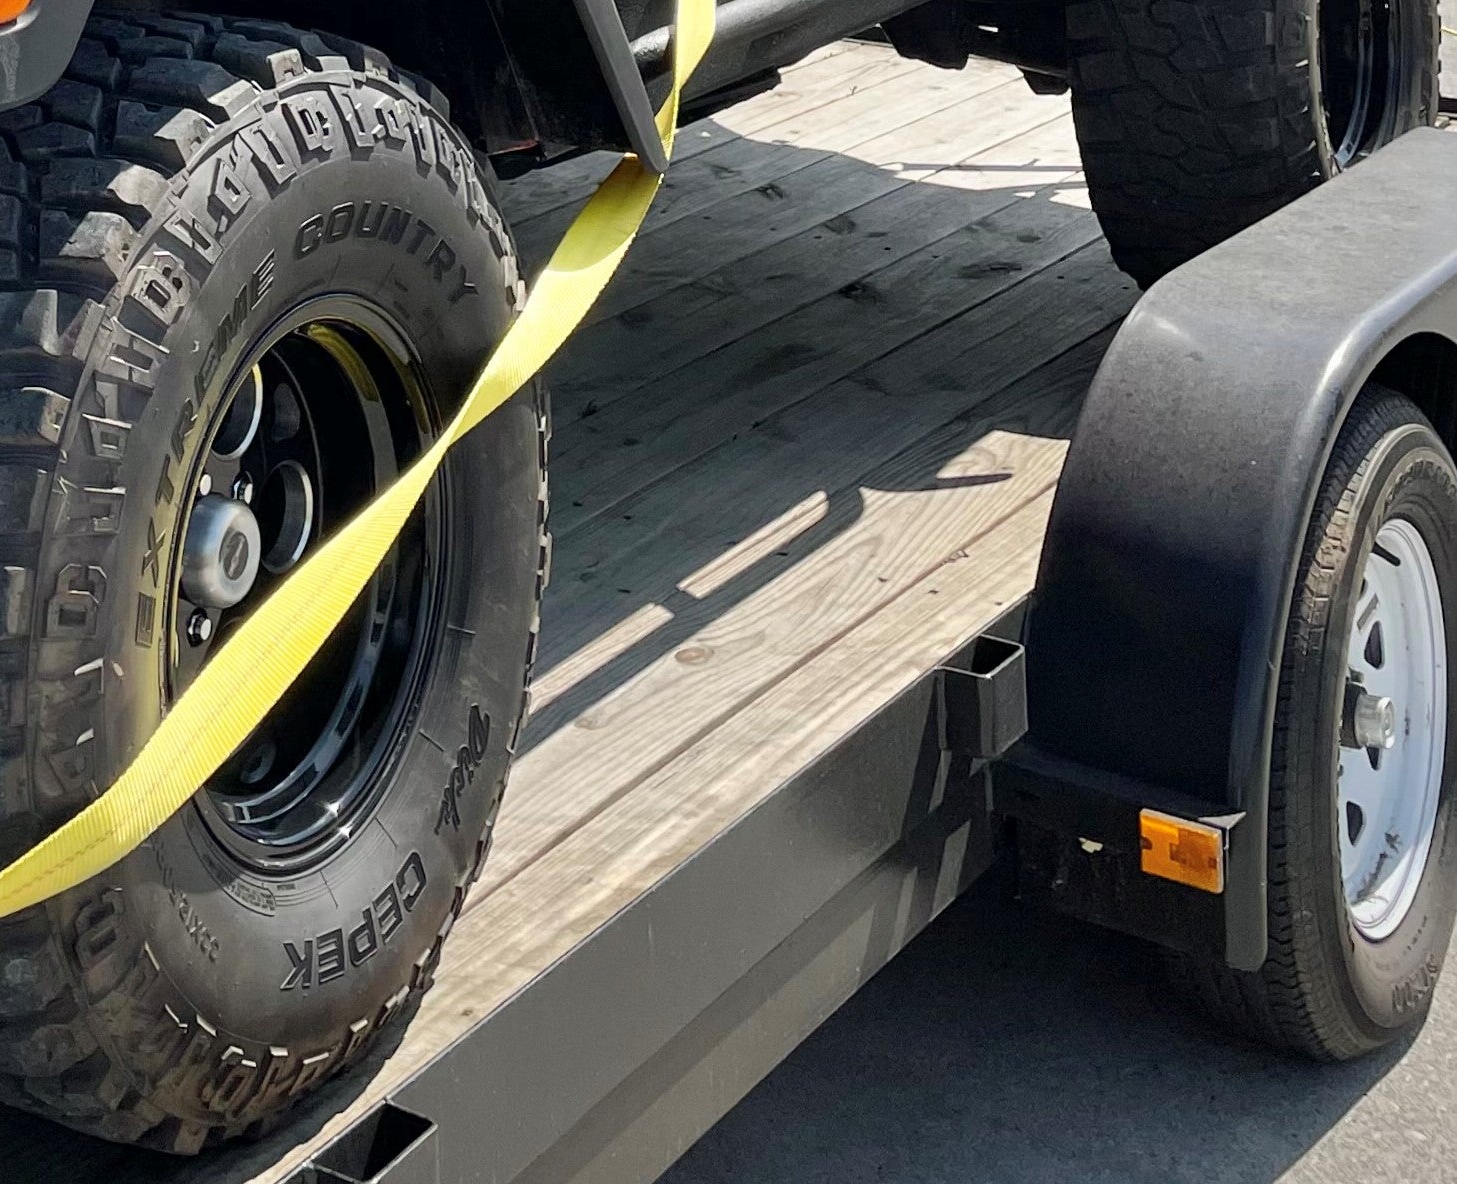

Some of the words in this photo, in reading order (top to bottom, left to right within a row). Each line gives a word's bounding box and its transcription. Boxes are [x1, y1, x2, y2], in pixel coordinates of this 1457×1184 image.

[134, 248, 277, 648] EXTREME
[294, 199, 479, 305] COUNTRY
[433, 702, 491, 836] Dick
[279, 850, 427, 992] CEPEK
